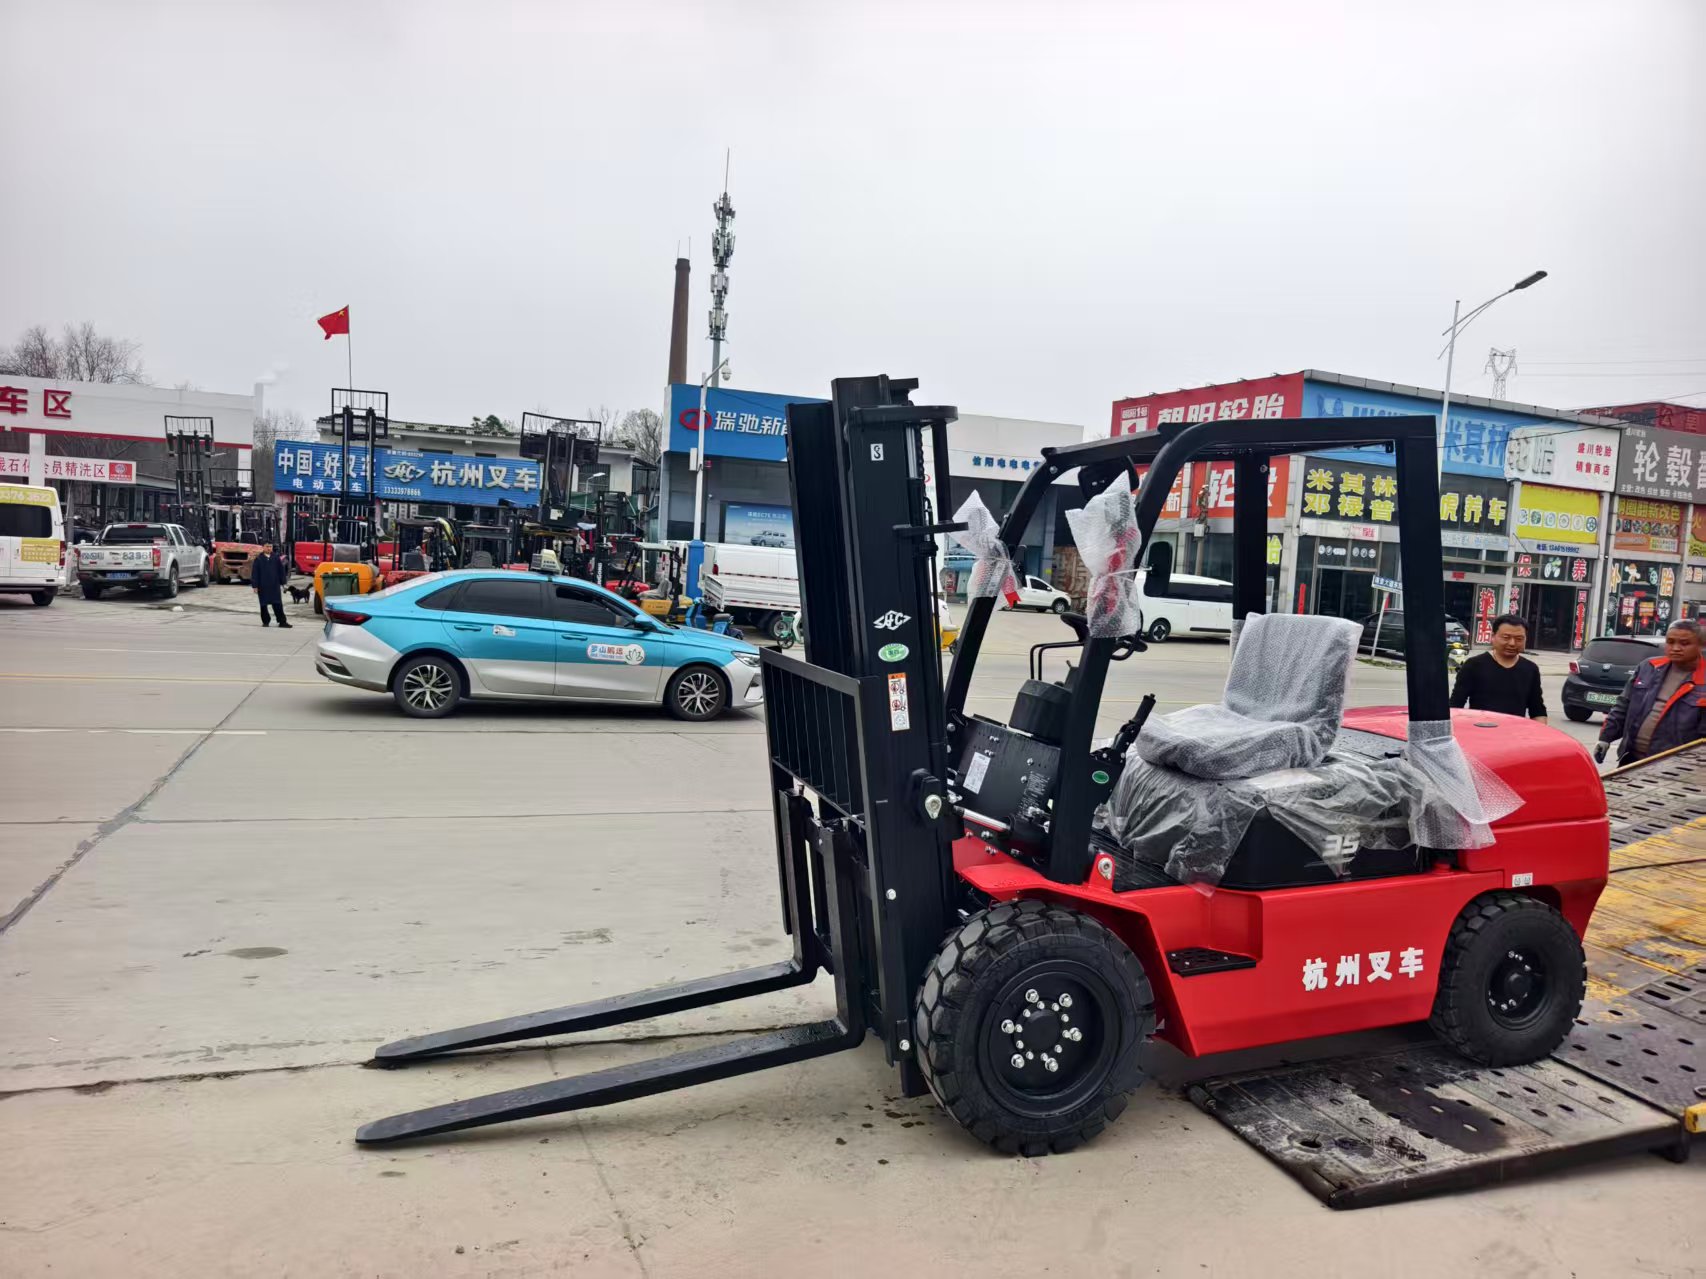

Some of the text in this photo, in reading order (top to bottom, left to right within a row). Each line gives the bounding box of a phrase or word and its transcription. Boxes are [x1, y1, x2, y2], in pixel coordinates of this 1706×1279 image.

[292, 479, 362, 493] 电动叉车
[430, 460, 538, 492] 杭州叉车
[1306, 468, 1397, 497] 米其林
[1303, 492, 1395, 522] 邓禄普
[1302, 947, 1424, 992] 杭州叉车
